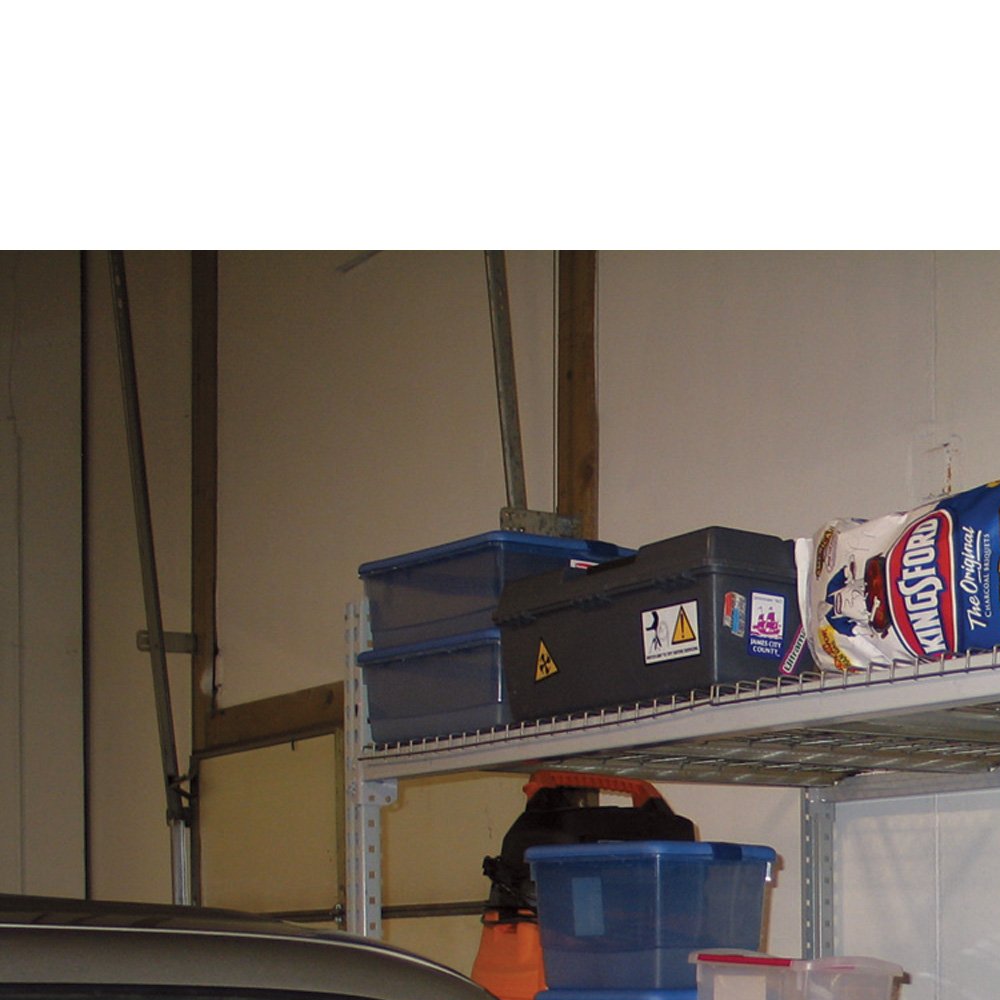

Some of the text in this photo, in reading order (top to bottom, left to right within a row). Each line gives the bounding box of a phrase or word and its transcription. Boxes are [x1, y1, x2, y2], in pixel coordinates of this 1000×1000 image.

[897, 517, 948, 655] KINGSFORD
[960, 526, 987, 631] The Original
[983, 533, 993, 618] CHARCOAL BRIQUETS
